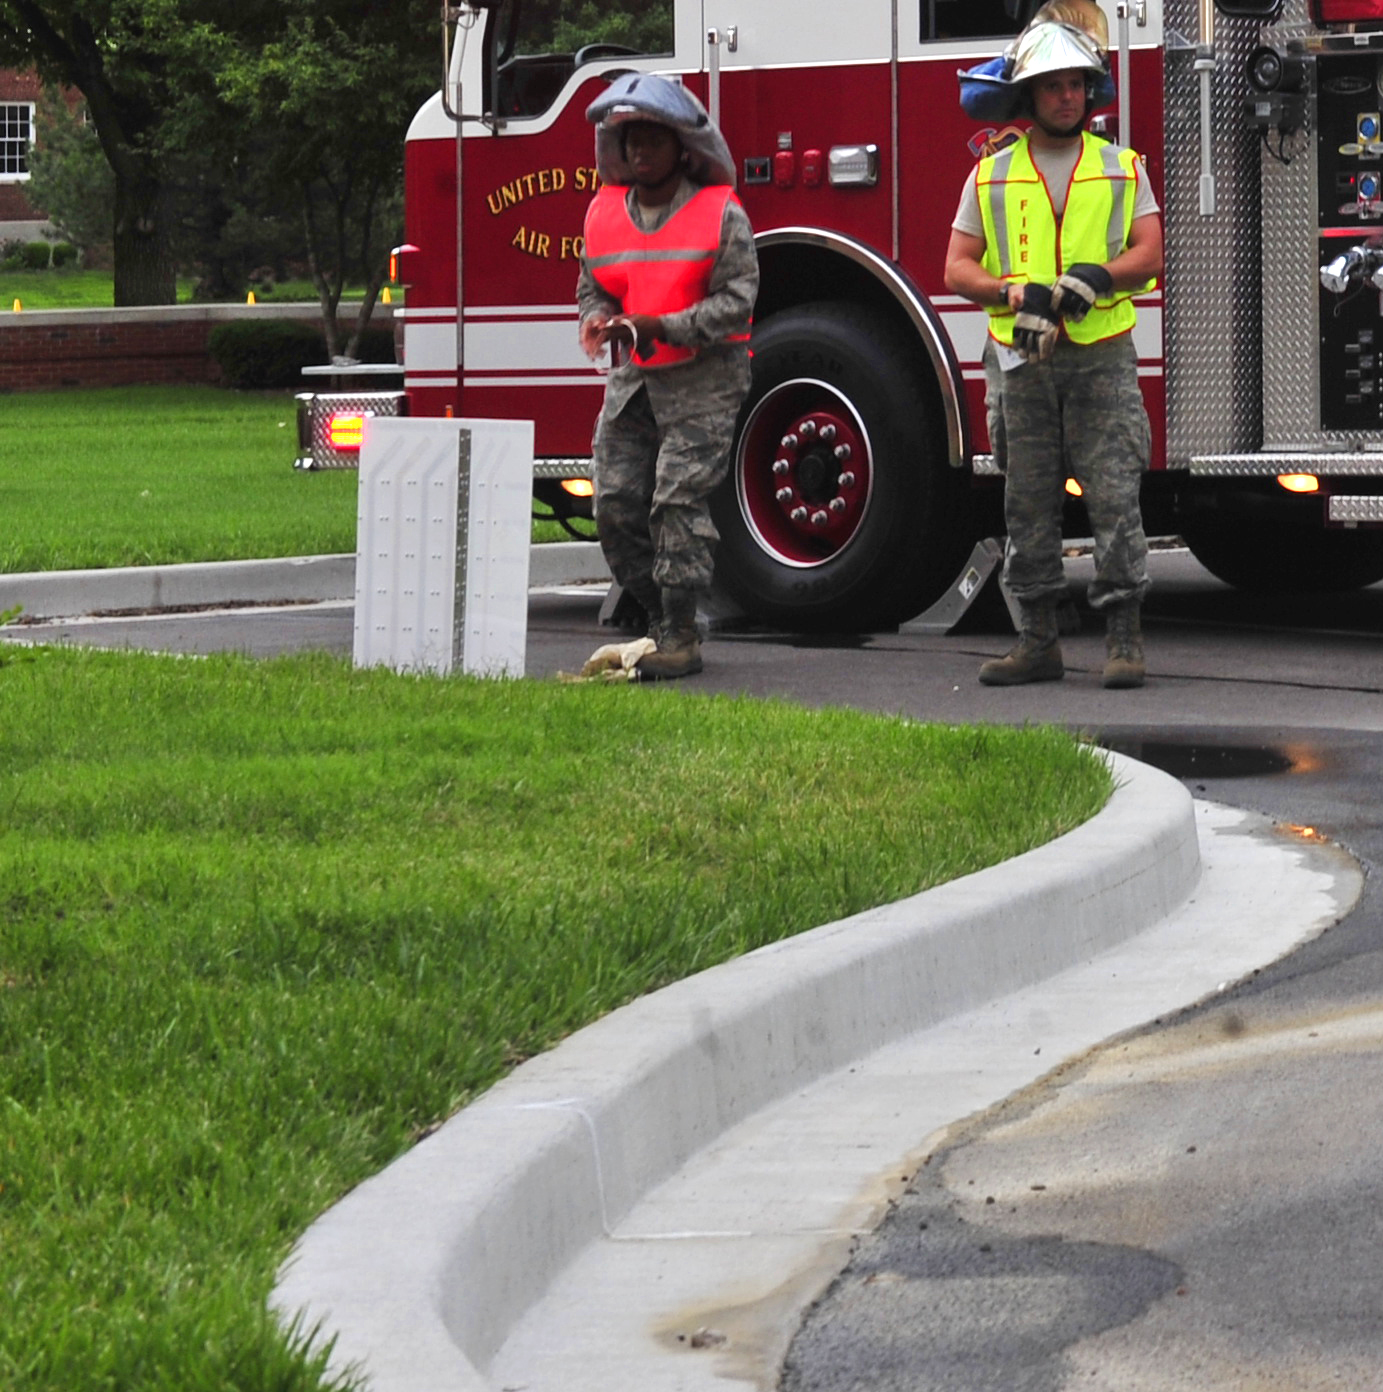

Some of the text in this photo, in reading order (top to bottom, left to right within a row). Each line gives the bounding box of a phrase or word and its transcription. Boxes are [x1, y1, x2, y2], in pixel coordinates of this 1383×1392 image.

[486, 167, 566, 215] UNITED
[511, 226, 551, 259] AIR
[1019, 199, 1029, 263] FIRE
